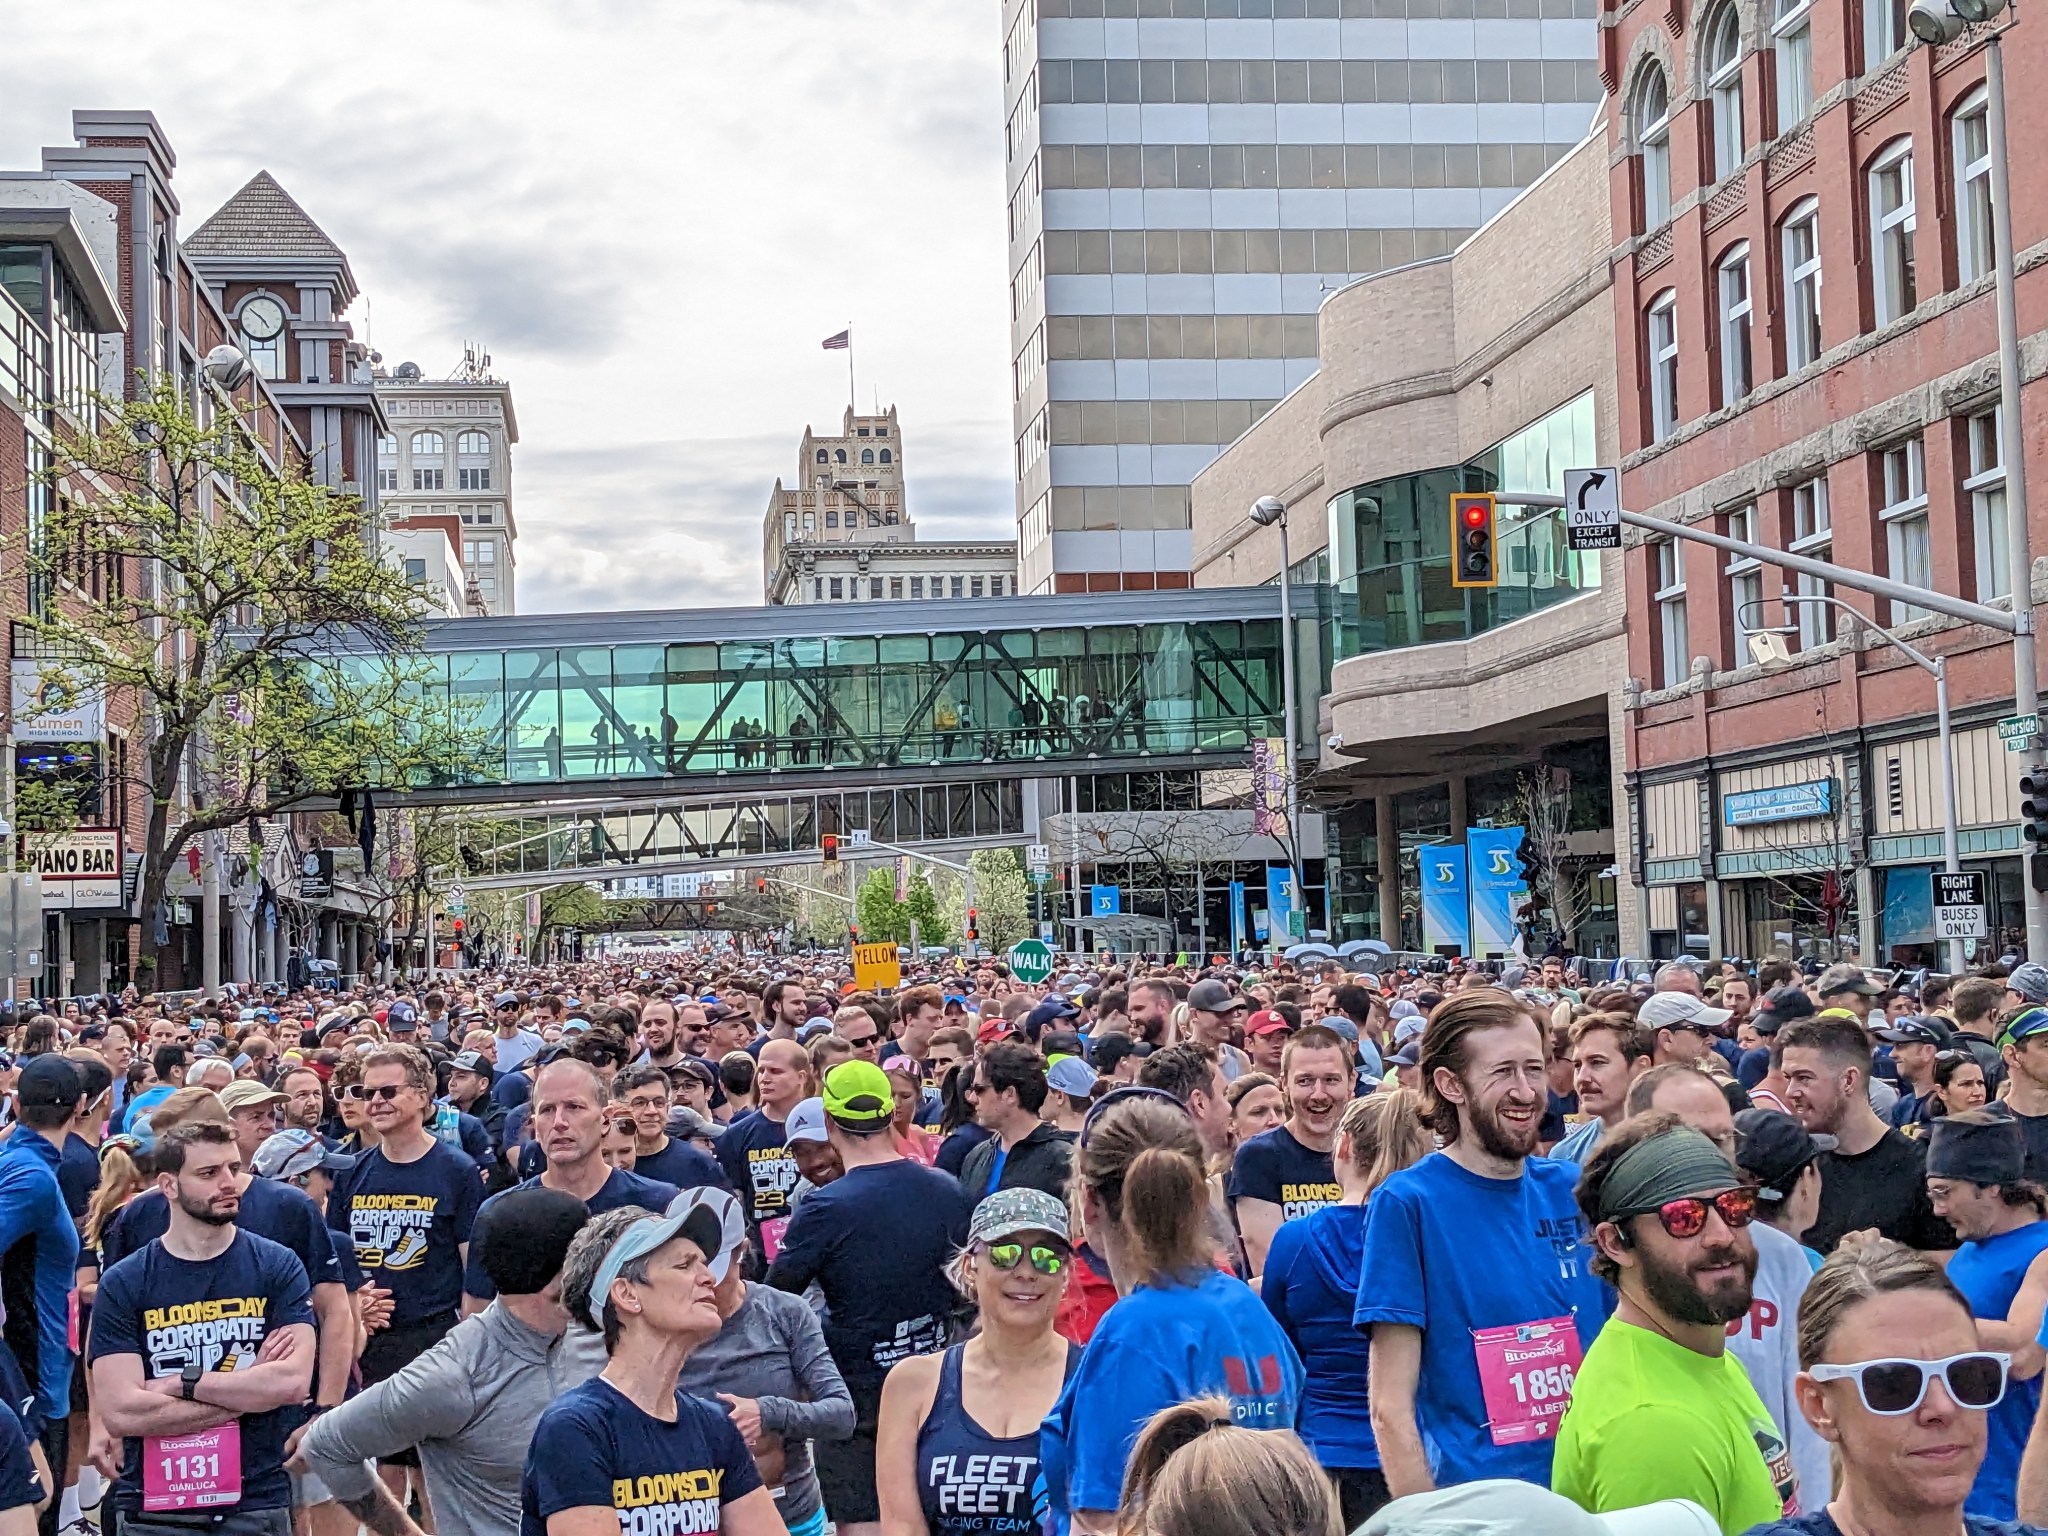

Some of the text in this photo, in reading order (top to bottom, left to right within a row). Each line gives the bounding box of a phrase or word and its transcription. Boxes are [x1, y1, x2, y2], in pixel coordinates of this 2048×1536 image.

[1574, 510, 1611, 524] ONLY
[1576, 526, 1613, 537] EXCEPT
[1574, 537, 1617, 548] TRANSIT
[28, 719, 83, 729] Lumen
[1999, 718, 2036, 737] Riverside
[27, 849, 115, 873] PIANO BAR
[1941, 875, 1975, 889] RIGHT
[1943, 890, 1975, 904] LANE
[1941, 908, 1978, 921] BUSES
[1945, 922, 1976, 935] ONLY
[855, 947, 897, 966] YELLOW
[1013, 952, 1050, 971] WALK
[752, 1172, 797, 1192] CUP
[351, 1194, 439, 1211] BLOOMSDAY
[755, 1191, 784, 1207] 23
[349, 1209, 435, 1228] CORPORATE
[350, 1226, 402, 1249] CUP
[144, 1297, 268, 1330] BLOOMSDAY
[146, 1317, 266, 1353] CORPORATE
[149, 1343, 224, 1378] CUP
[1503, 1340, 1565, 1363] BLOOMSDAY
[1509, 1363, 1574, 1402] 1856
[160, 1435, 220, 1452] BLOOMSDAY
[160, 1453, 219, 1481] 1131
[929, 1455, 1038, 1487] FLEET
[168, 1480, 217, 1492] GIANLUCA
[939, 1483, 1025, 1514] FEET
[988, 1517, 1031, 1532] TEAM
